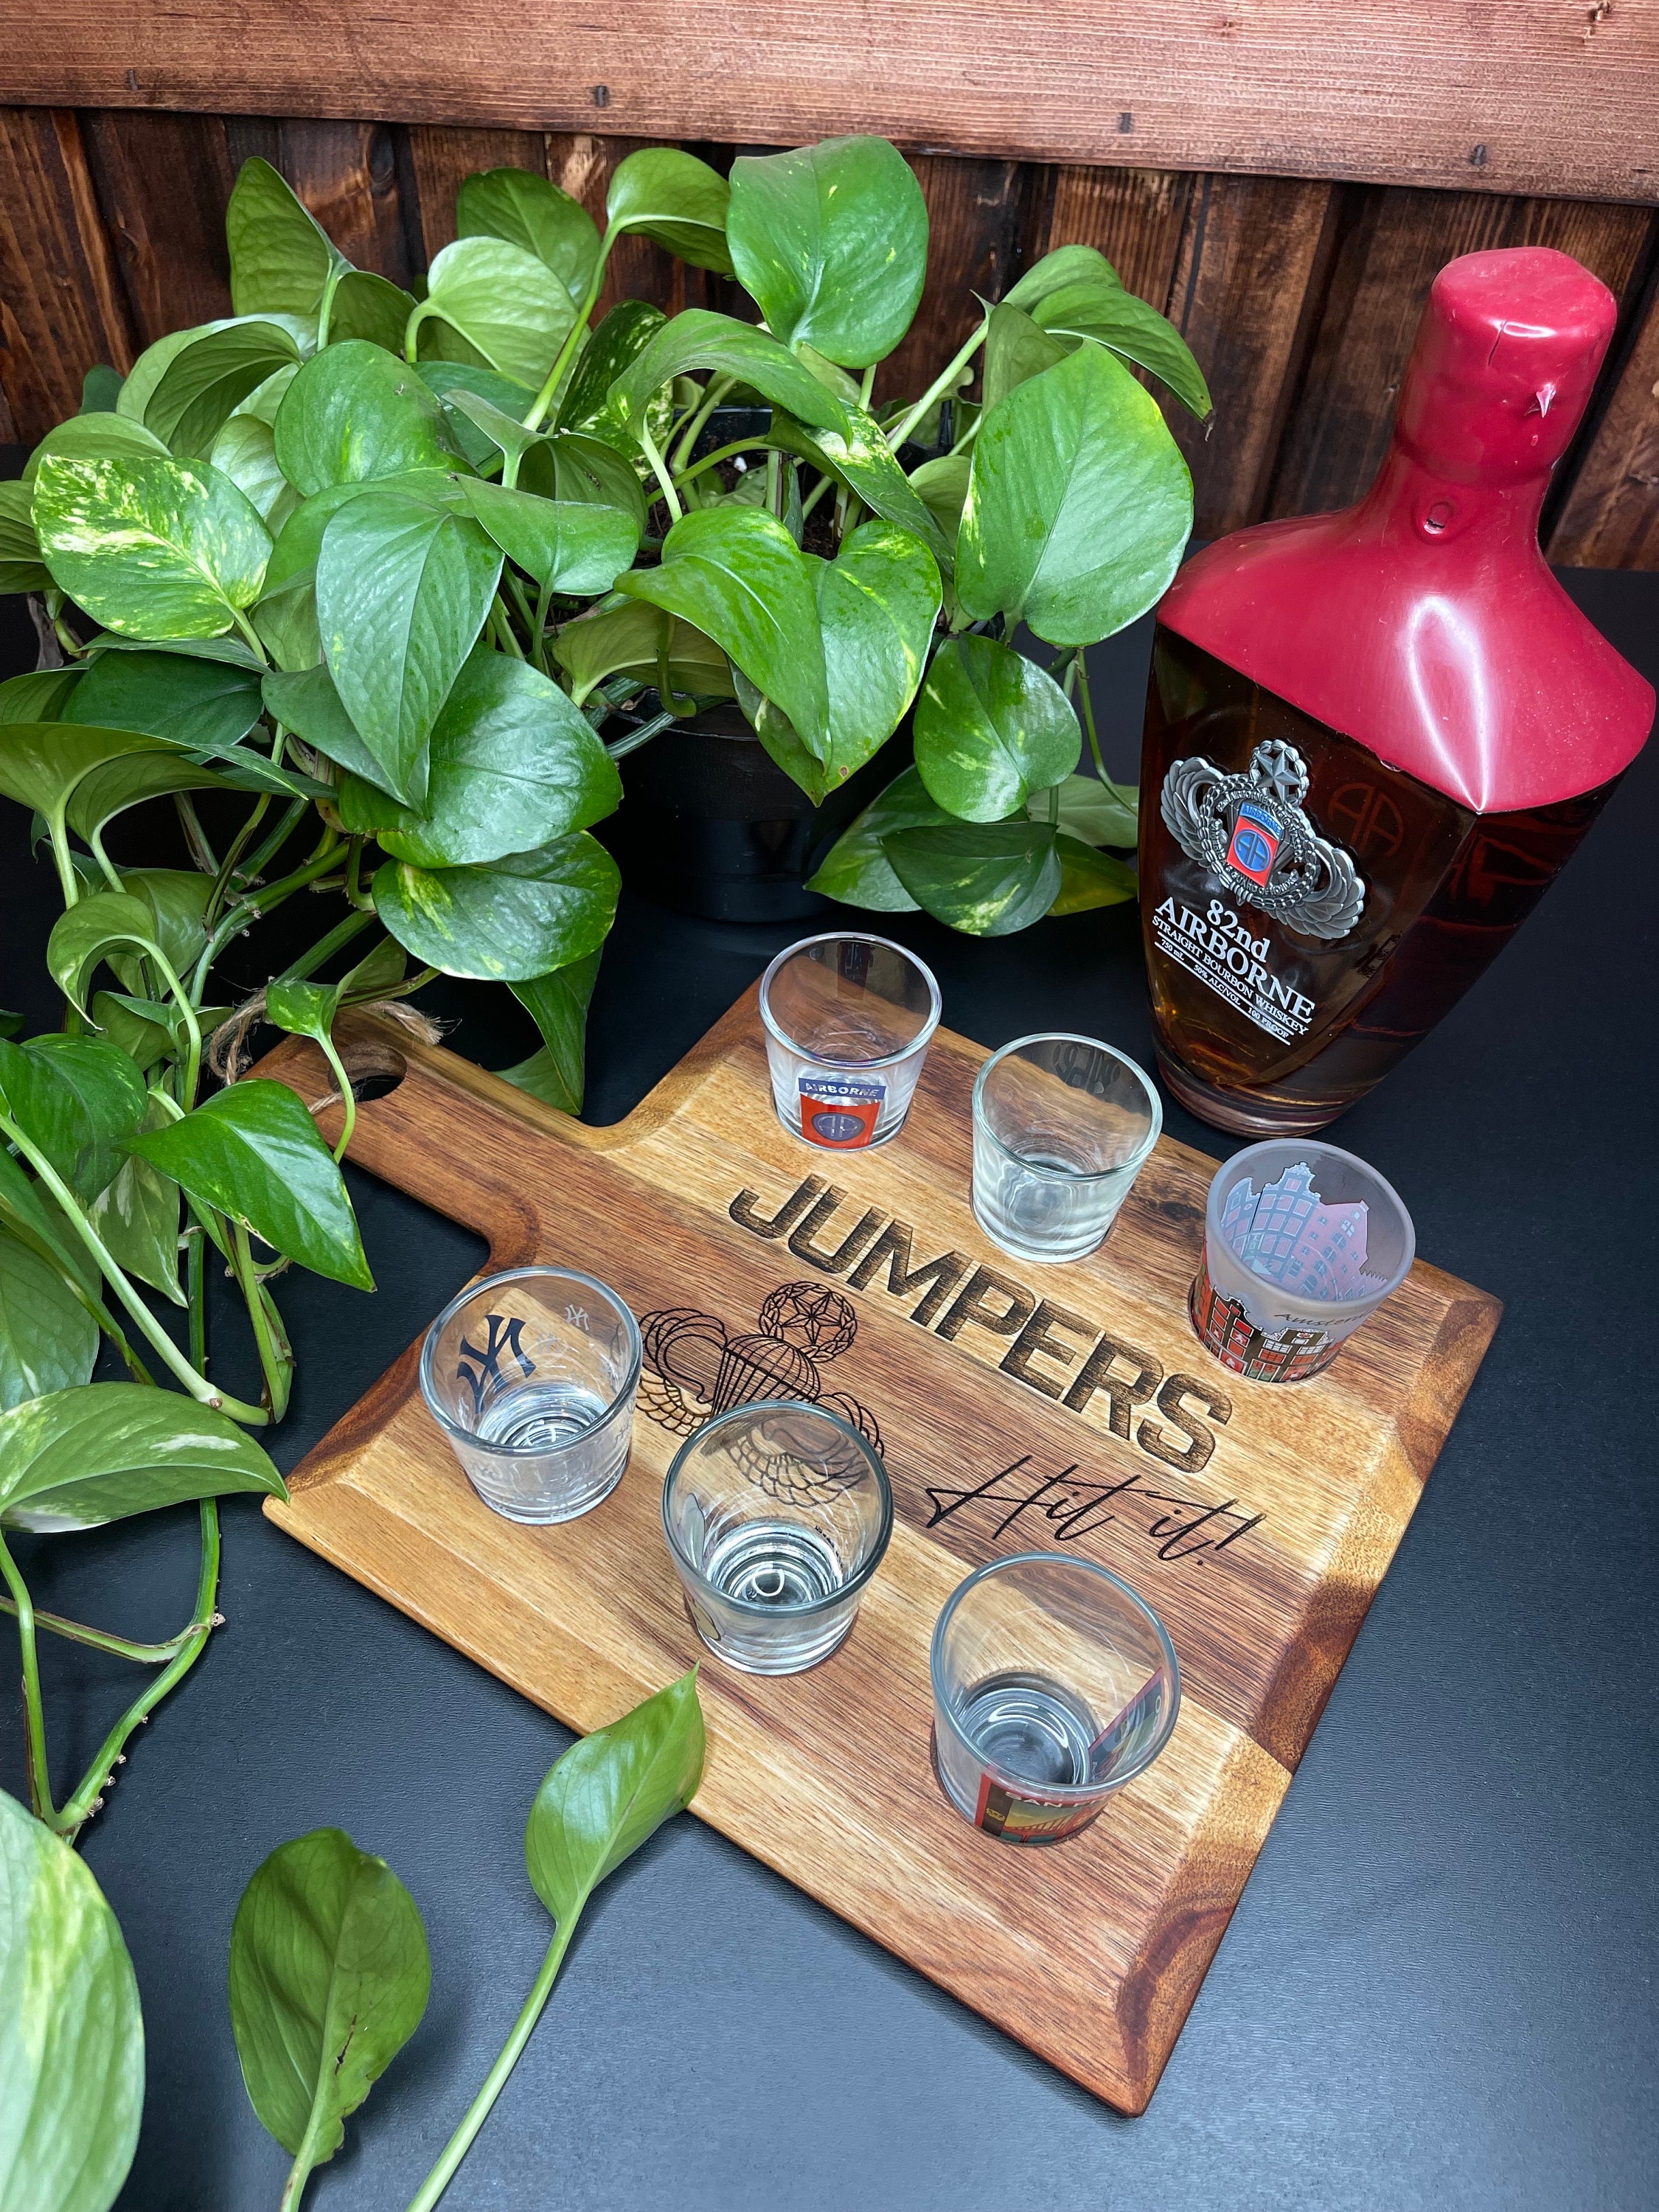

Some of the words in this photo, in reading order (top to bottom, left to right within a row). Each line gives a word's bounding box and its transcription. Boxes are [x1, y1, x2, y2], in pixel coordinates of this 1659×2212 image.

[1242, 804, 1282, 835] AIRBORNE
[1152, 915, 1203, 958] STRAIGHT
[1203, 953, 1253, 998] BOURBON
[1255, 994, 1309, 1035] WHISKEY
[1155, 897, 1316, 1024] AIRBORNE
[1207, 899, 1270, 962] 82nd
[1161, 939, 1173, 952] 750
[1173, 949, 1184, 961] mL
[1194, 964, 1208, 979] 50%
[1208, 977, 1241, 1006] ALC/VOL
[1248, 1007, 1261, 1020] 100
[1262, 1017, 1290, 1038] PROOF
[805, 1082, 880, 1097] AIRBORNE
[728, 1174, 1233, 1474] JUMPERS
[926, 1455, 1154, 1541] Hit
[1145, 1491, 1267, 1567] it!
